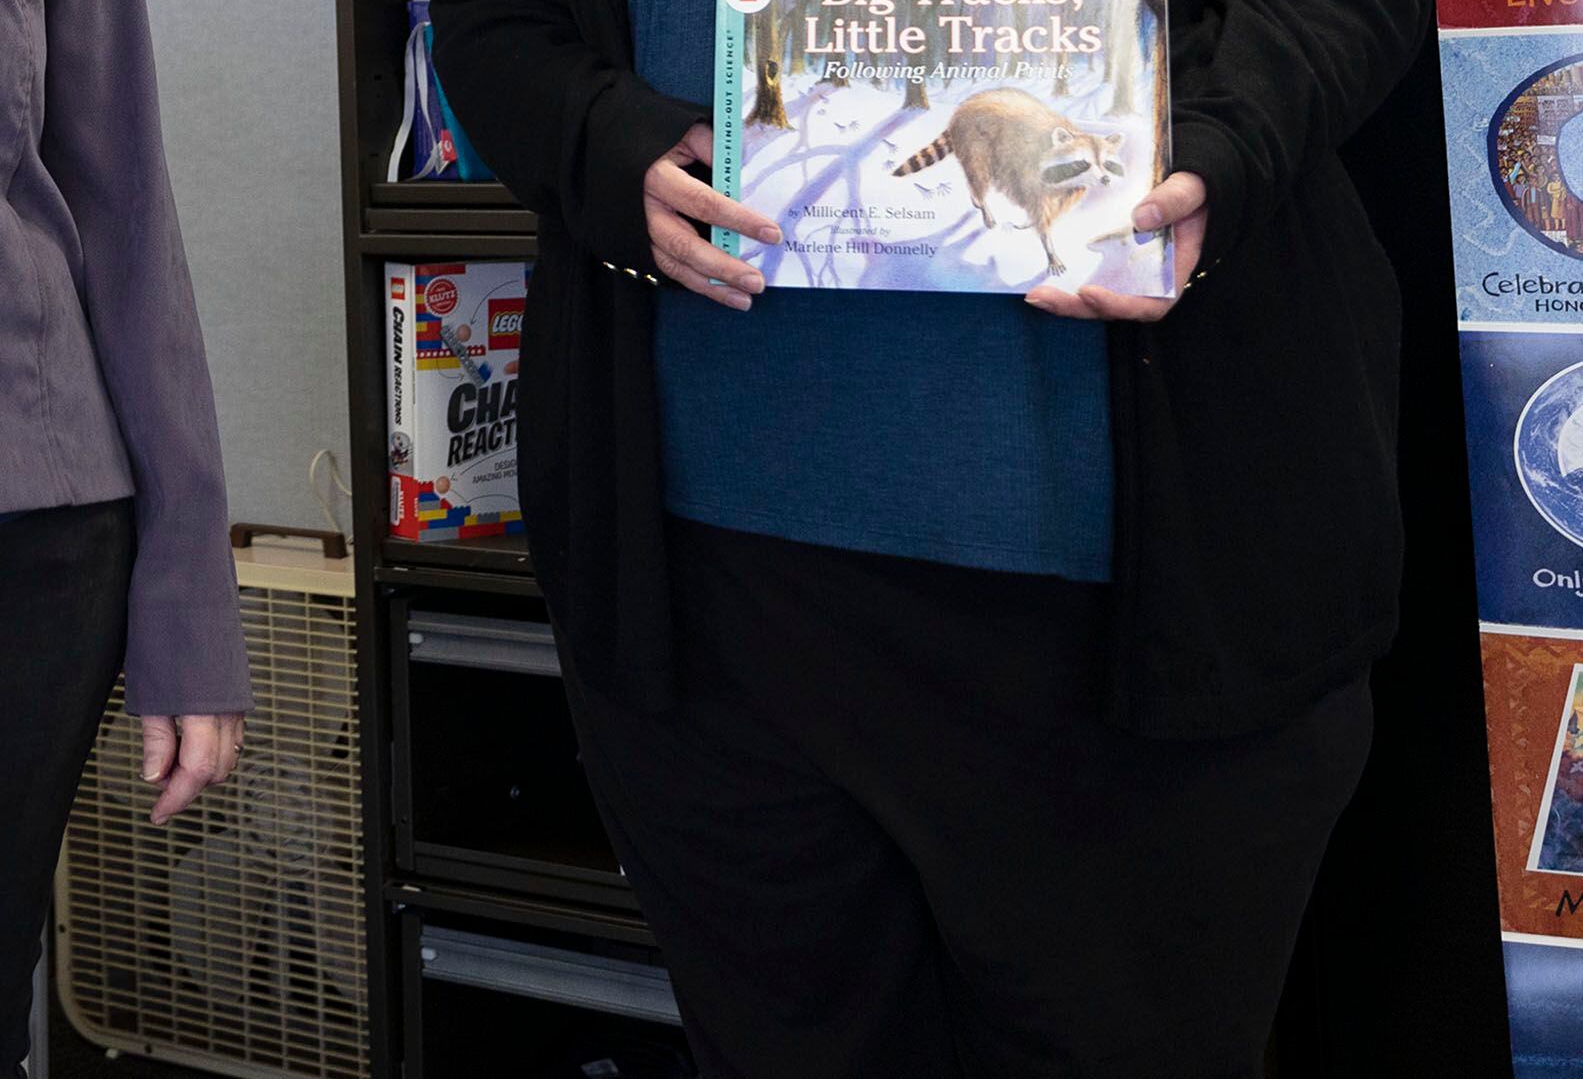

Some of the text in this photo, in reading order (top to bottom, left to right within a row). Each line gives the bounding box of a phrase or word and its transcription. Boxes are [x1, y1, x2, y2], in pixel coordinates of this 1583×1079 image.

[804, 16, 1102, 54] Little Tracks
[823, 61, 1075, 84] Following Animal Prints
[788, 205, 936, 220] by Millicent E. Selsam
[879, 227, 891, 237] by
[784, 240, 939, 258] Marlene Hill Donnelly
[1482, 272, 1583, 297] Celebra
[392, 305, 405, 365] CHAIN
[492, 313, 524, 334] LEG
[393, 365, 403, 425] REACTIONS
[447, 378, 518, 435] CHA
[447, 417, 517, 468] REACT
